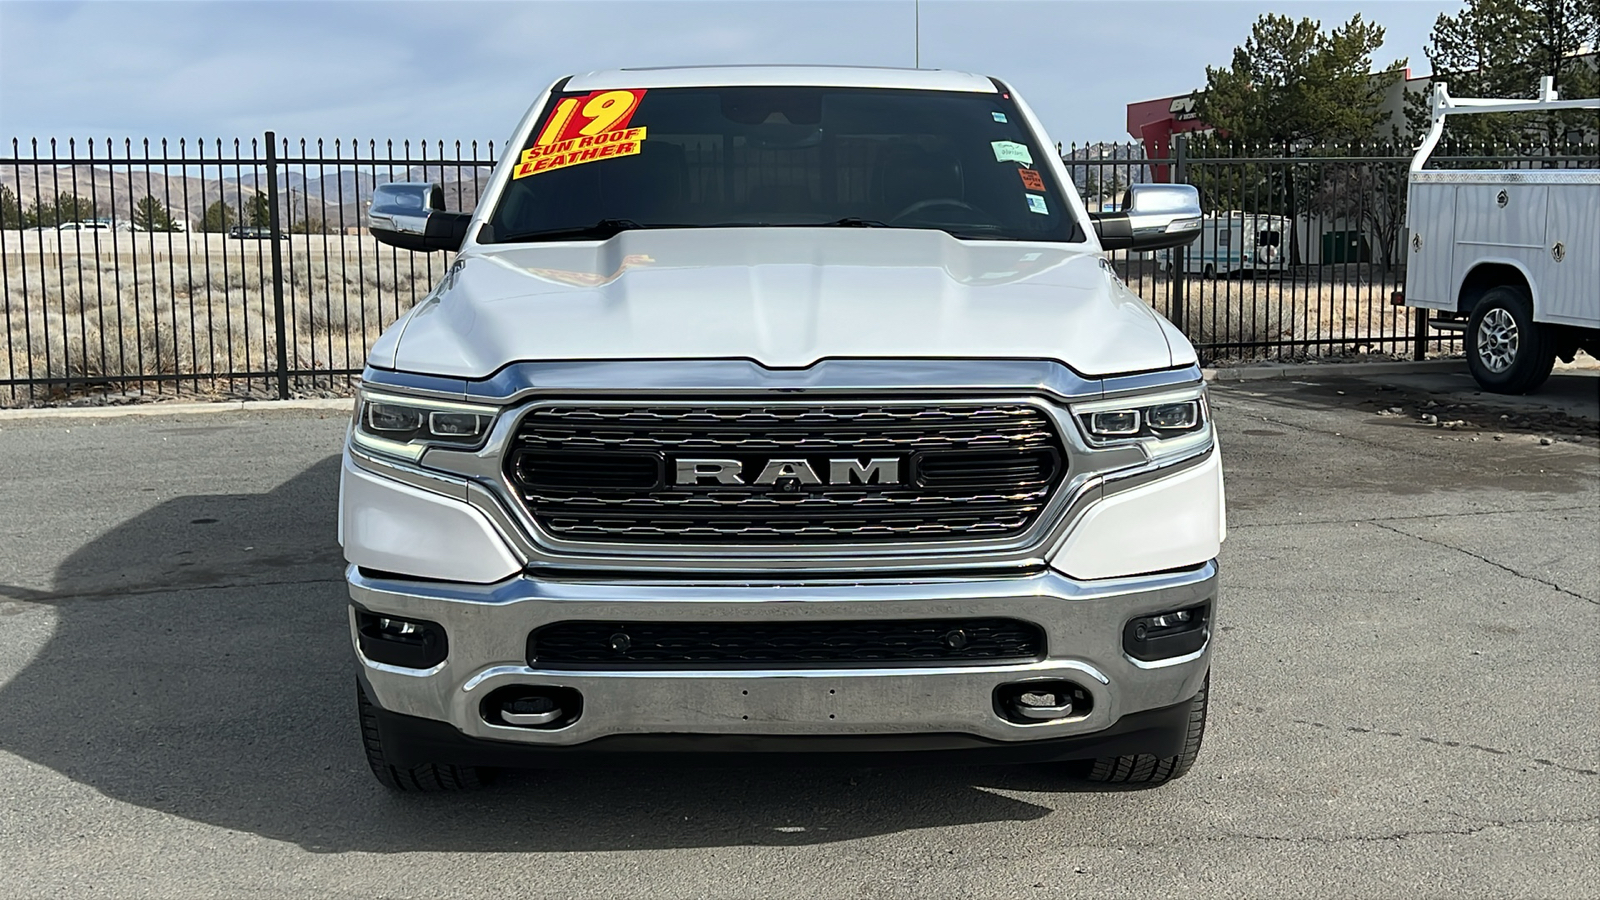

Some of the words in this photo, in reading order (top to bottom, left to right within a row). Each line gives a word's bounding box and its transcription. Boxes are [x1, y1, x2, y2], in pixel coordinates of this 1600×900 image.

[537, 90, 637, 146] 19
[519, 142, 637, 176] LEATHER
[528, 140, 577, 160] SUN
[578, 129, 641, 148] ROOF
[675, 458, 900, 485] RAM
